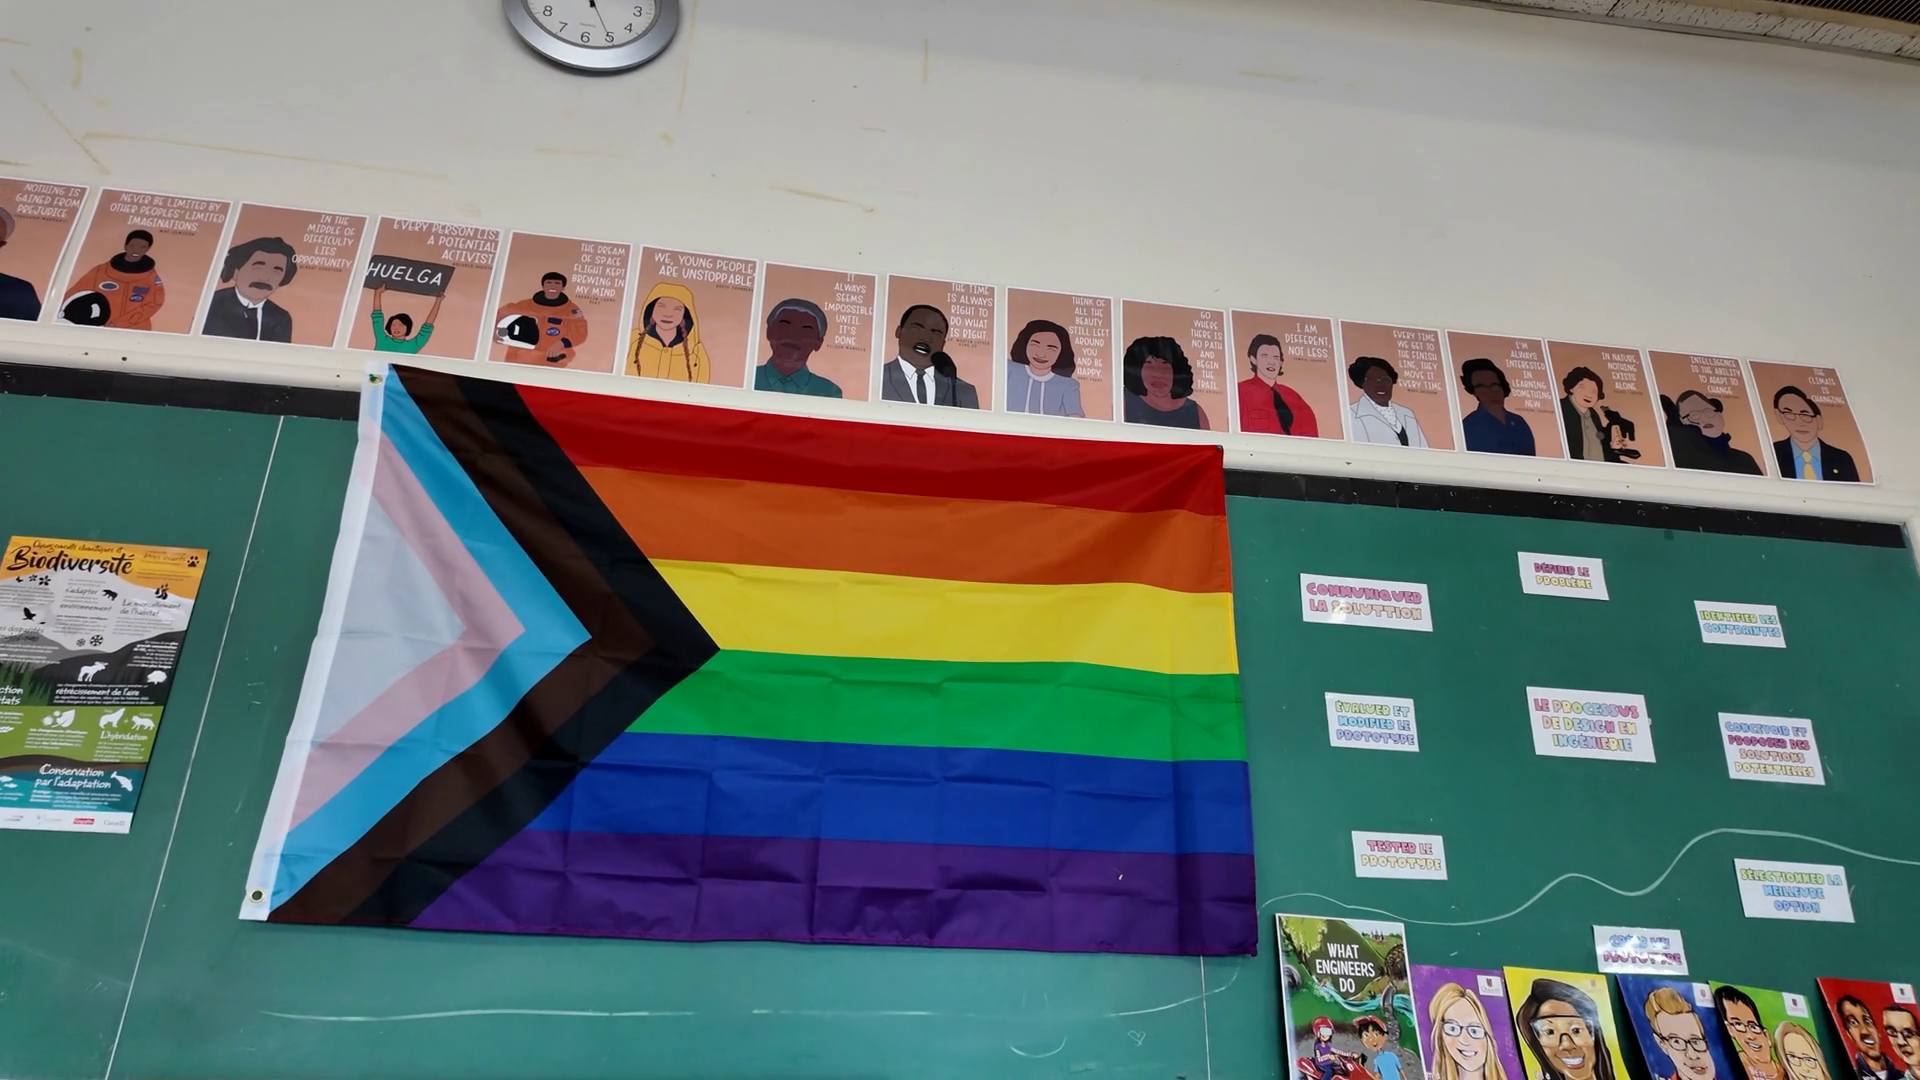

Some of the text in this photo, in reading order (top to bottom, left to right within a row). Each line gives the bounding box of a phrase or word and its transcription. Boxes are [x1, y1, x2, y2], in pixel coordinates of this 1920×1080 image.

[543, 5, 553, 16] 8
[633, 6, 643, 17] 3
[558, 21, 568, 33] 7
[624, 23, 633, 33] 4
[581, 32, 590, 43] 6
[605, 32, 615, 43] 5
[120, 194, 221, 212] NEVER BE LIMITED BY
[110, 203, 138, 213] OTHER
[186, 212, 225, 223] LIMITED
[320, 215, 350, 225] IN THE
[307, 224, 356, 236] MIDDLE OF
[393, 219, 474, 238] EVERY PERSON
[303, 234, 354, 246] DIFFICULTY
[427, 235, 497, 252] A POTENTIAL
[315, 246, 337, 256] LIES
[581, 243, 625, 256] THE DREAM
[582, 254, 621, 266] OF SPACE
[655, 252, 674, 265] WE,
[678, 255, 712, 268] YOUNG
[366, 262, 442, 286] HUELGA
[574, 263, 625, 277] FLIGHT KEPT
[659, 266, 678, 277] ARE
[572, 274, 624, 287] BREWING IN
[576, 285, 615, 297] MY MIND
[834, 282, 866, 293] ALWAYS
[952, 283, 989, 295] THE TIME
[836, 293, 863, 303] SEEMS
[947, 293, 993, 306] IS ALWAYS
[1072, 297, 1094, 306] THINK
[952, 305, 988, 317] RIGHT TO
[1075, 307, 1103, 317] ALL THE
[836, 315, 860, 325] UNTIL
[950, 316, 988, 328] DO WHAT
[1075, 317, 1102, 327] BEAUTY
[839, 325, 856, 335] IT'S
[950, 328, 959, 337] IS
[1069, 326, 1109, 337] STILL LEFT
[1297, 323, 1318, 333] I AM
[1075, 337, 1104, 346] AROUND
[1083, 348, 1097, 356] YOU
[1289, 346, 1303, 356] NOT
[1077, 358, 1103, 367] AND BE
[7, 545, 135, 576] Biodiversité
[1534, 562, 1590, 576] DÉFINIR LE
[1306, 582, 1422, 604] COMMUNIQUER
[1309, 599, 1328, 612] LA
[1700, 611, 1777, 625] IDENTIFIER LES
[1703, 623, 1781, 637] CONTRAINTES
[1335, 700, 1409, 717] ÉVALUER ET
[1534, 698, 1639, 719] LE PROCESSUS
[1338, 715, 1411, 731] MODIFIER LE
[1542, 715, 1637, 735] DE DESIGN EN
[1725, 721, 1807, 737] CONCEVOIR ET
[1336, 729, 1415, 745] PROTOTYPE
[1552, 733, 1632, 751] INGÉNIERIE
[1728, 735, 1810, 750] PROPOSER DES
[1739, 748, 1805, 763] SOLUTIONS
[39, 763, 104, 777] Conservation
[1734, 762, 1815, 777] POTENTIELLES
[35, 778, 53, 787] par
[1367, 840, 1433, 855] TESTER LE
[1361, 854, 1442, 870] PROTOTYPE
[1826, 874, 1843, 885] LA
[1763, 885, 1825, 899] MEILLEURE
[1774, 900, 1820, 913] OPTION
[1327, 943, 1359, 959] WHAT
[1316, 959, 1375, 977] ENGINEERS
[1339, 978, 1355, 992] DO
